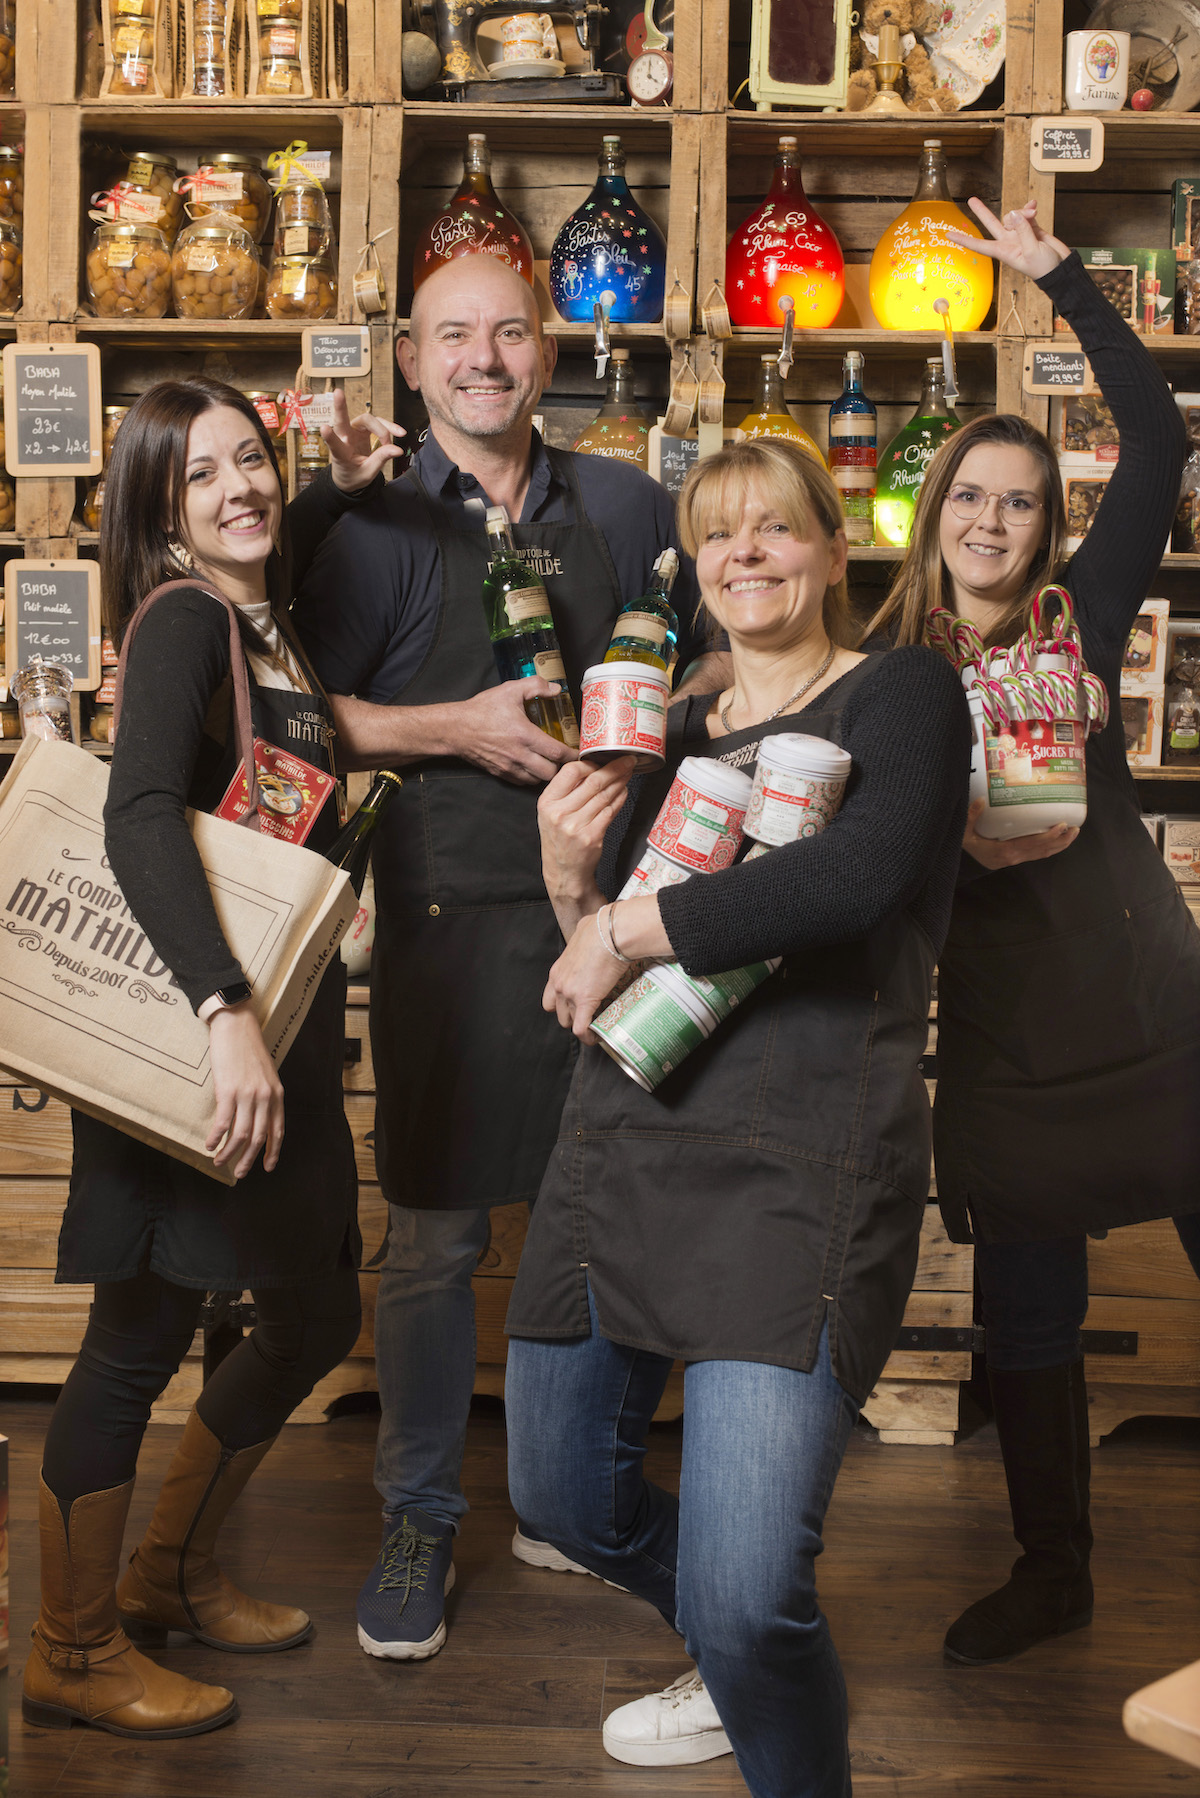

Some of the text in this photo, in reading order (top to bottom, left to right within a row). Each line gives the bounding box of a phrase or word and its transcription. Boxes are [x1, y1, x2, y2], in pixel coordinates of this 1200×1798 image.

[1082, 84, 1120, 101] Farine
[785, 211, 808, 226] 69
[795, 233, 823, 253] Coco
[889, 235, 921, 258] Rhum
[325, 354, 351, 367] 21€
[1042, 362, 1085, 372] mendiants
[24, 365, 61, 379] BABA
[21, 384, 45, 400] Moyen
[32, 417, 61, 434] 23€
[65, 437, 90, 455] 42€
[21, 582, 57, 596] BABA
[1032, 744, 1067, 760] SUCRES
[47, 868, 65, 886] LE
[42, 940, 128, 989] Depuis 2007
